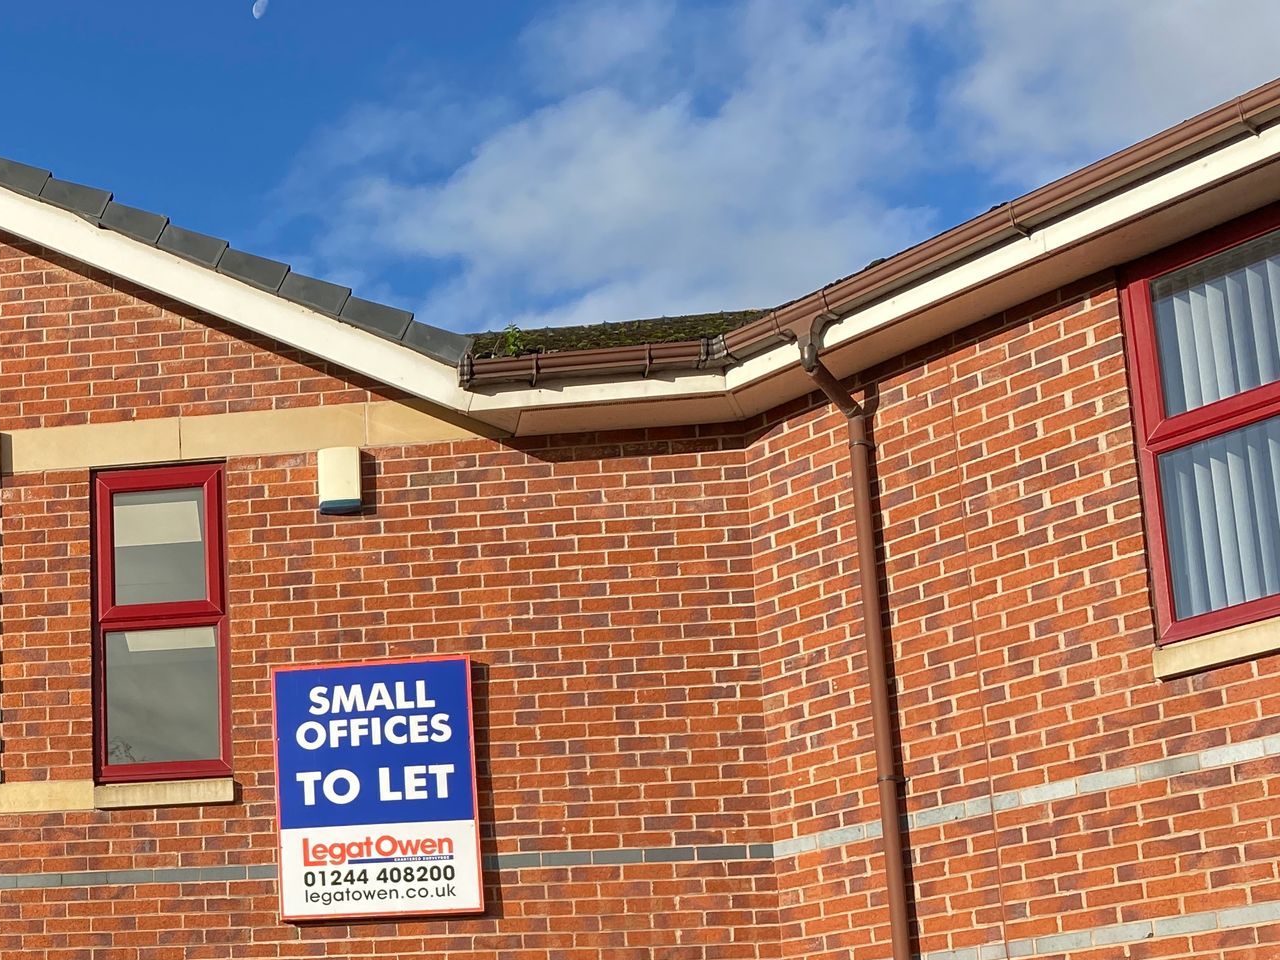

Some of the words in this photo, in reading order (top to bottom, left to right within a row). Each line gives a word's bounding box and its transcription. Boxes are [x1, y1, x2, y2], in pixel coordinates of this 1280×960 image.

[308, 680, 436, 715] SMALL
[295, 713, 452, 750] OFFICES
[296, 768, 361, 806] TO
[378, 763, 455, 801] LET
[304, 868, 369, 887] 01244
[376, 865, 456, 884] 408200
[305, 883, 457, 906] legatowen.co.uk
